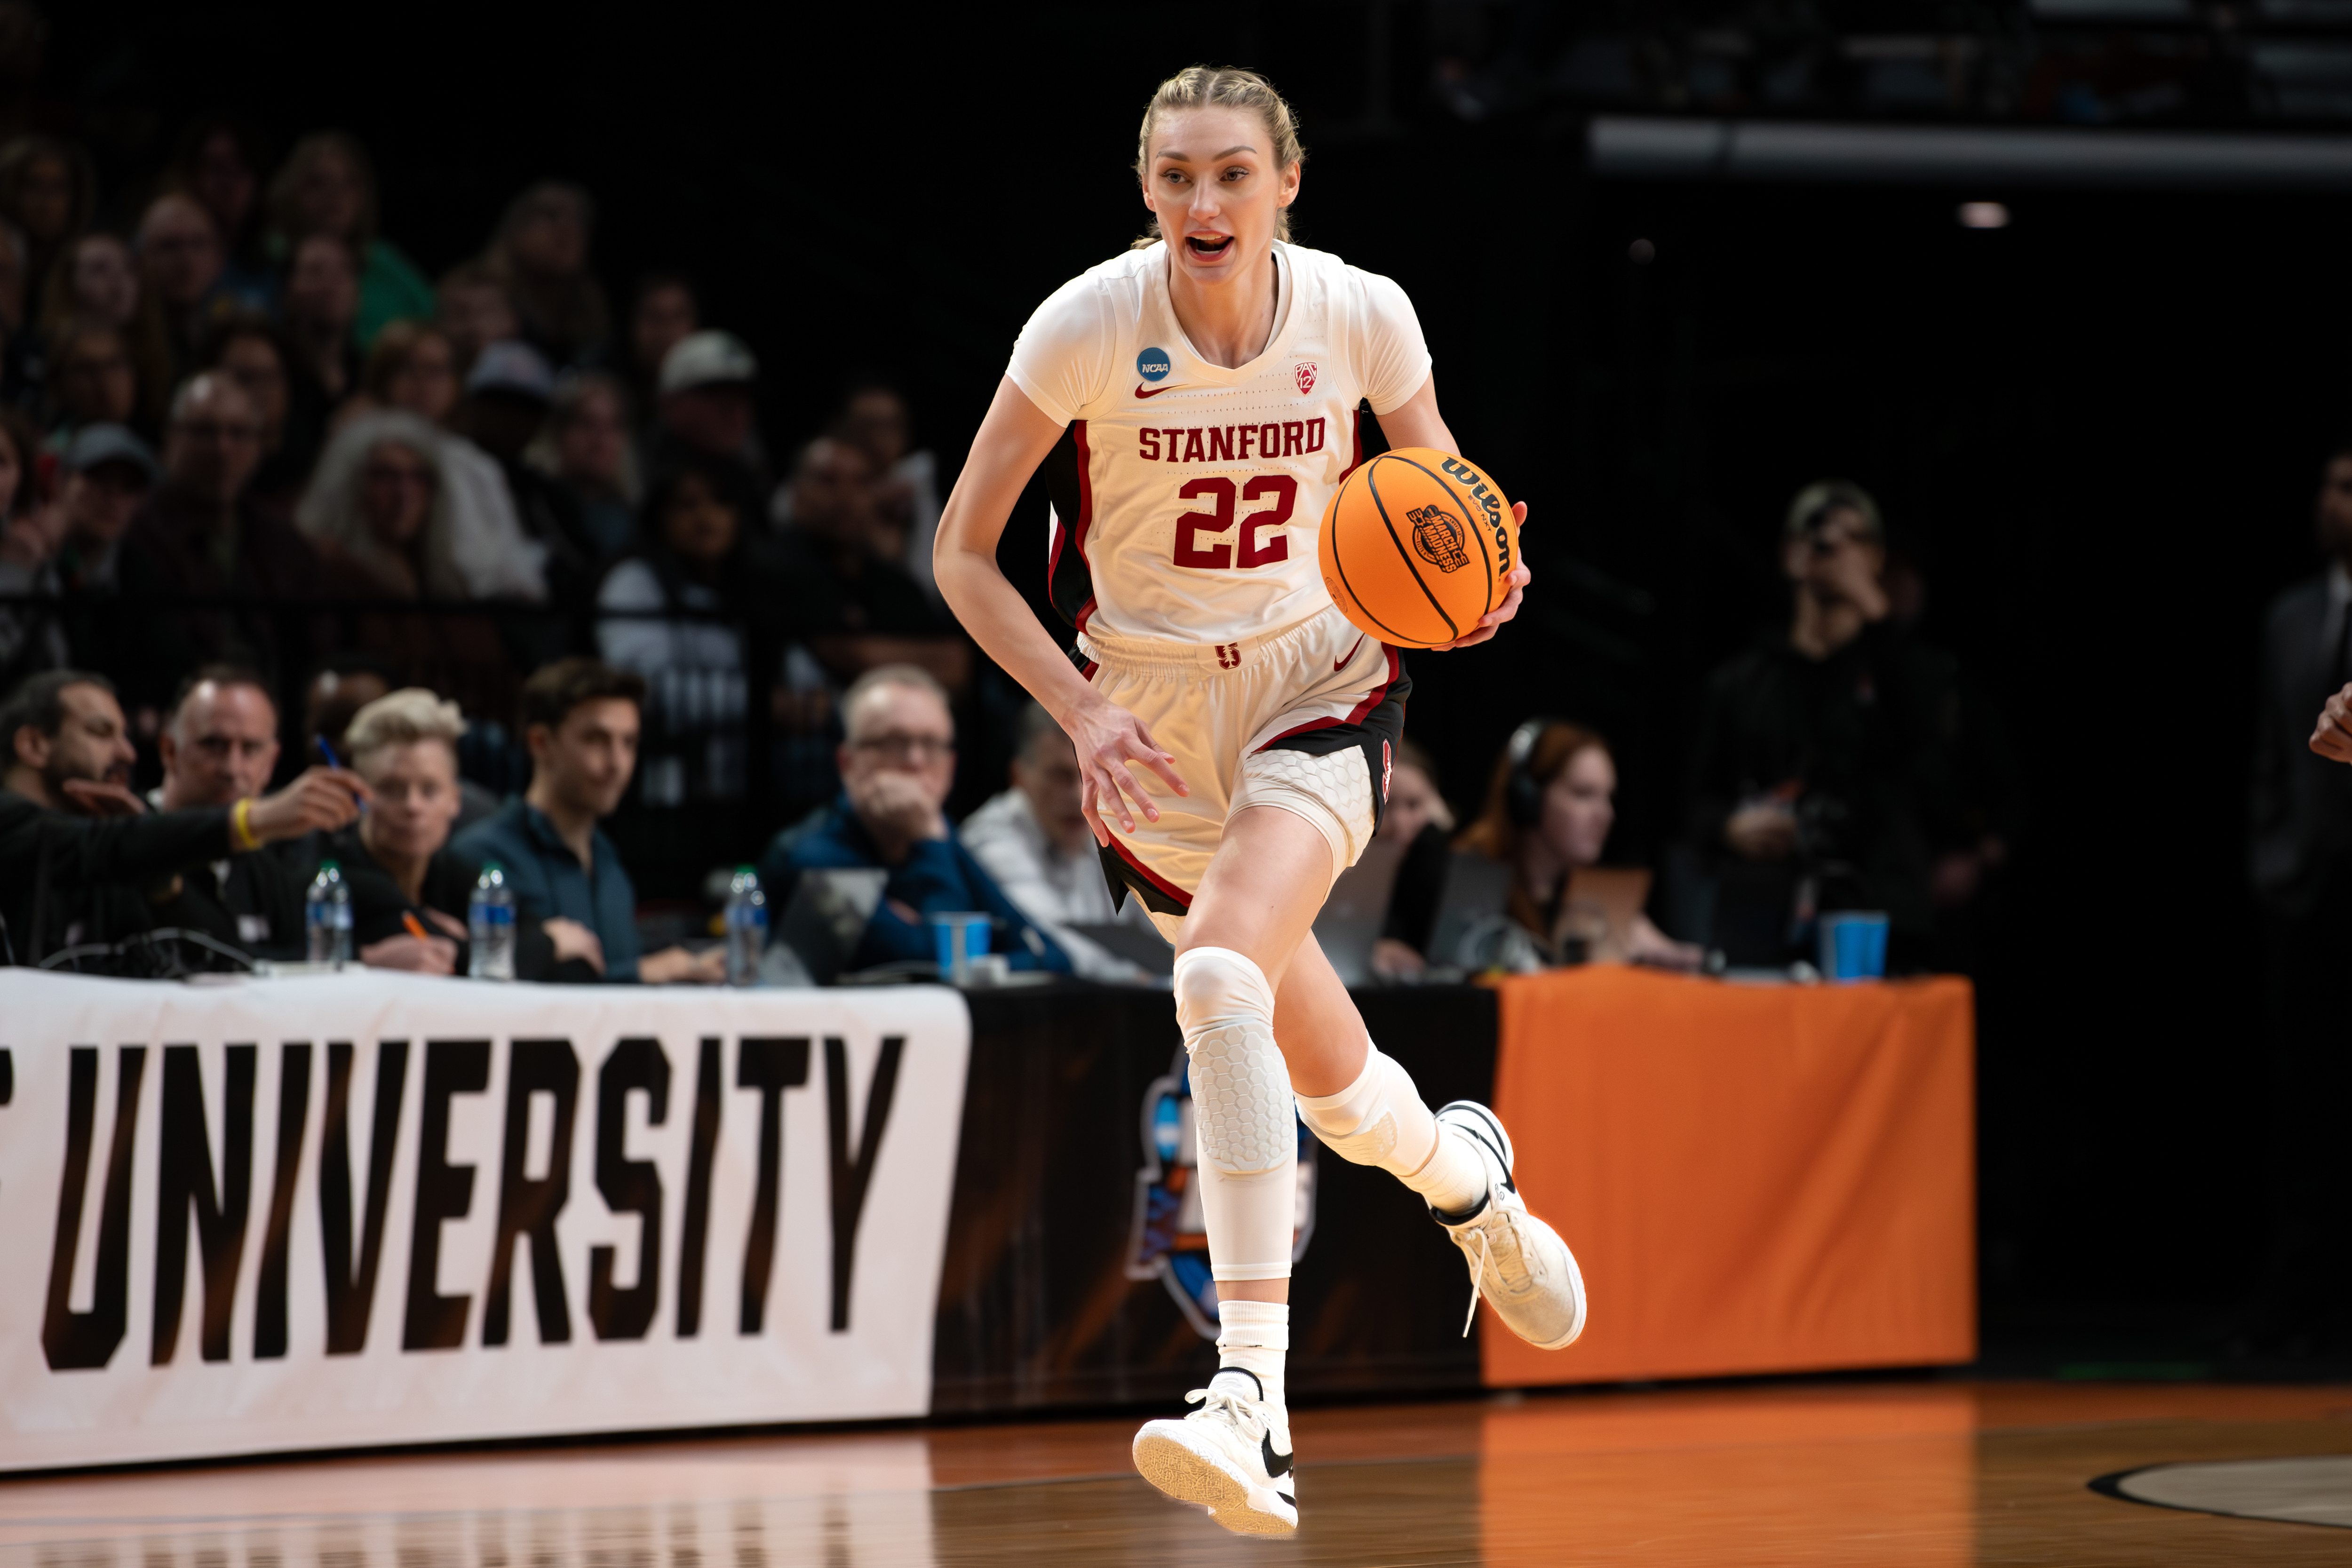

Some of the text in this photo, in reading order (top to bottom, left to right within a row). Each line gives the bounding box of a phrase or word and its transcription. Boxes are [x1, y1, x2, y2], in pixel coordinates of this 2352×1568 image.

[1142, 364, 1168, 373] NCAA
[1295, 363, 1317, 383] PAC
[1300, 375, 1312, 389] 12
[1139, 417, 1326, 462] STANFORD
[1173, 475, 1298, 569] 22
[1430, 515, 1458, 551] MARCH
[1441, 456, 1510, 577] Wilson
[1468, 494, 1492, 532] EVO NXT
[1423, 525, 1457, 573] MADNESS
[40, 1035, 906, 1373] UNIVERSITY
